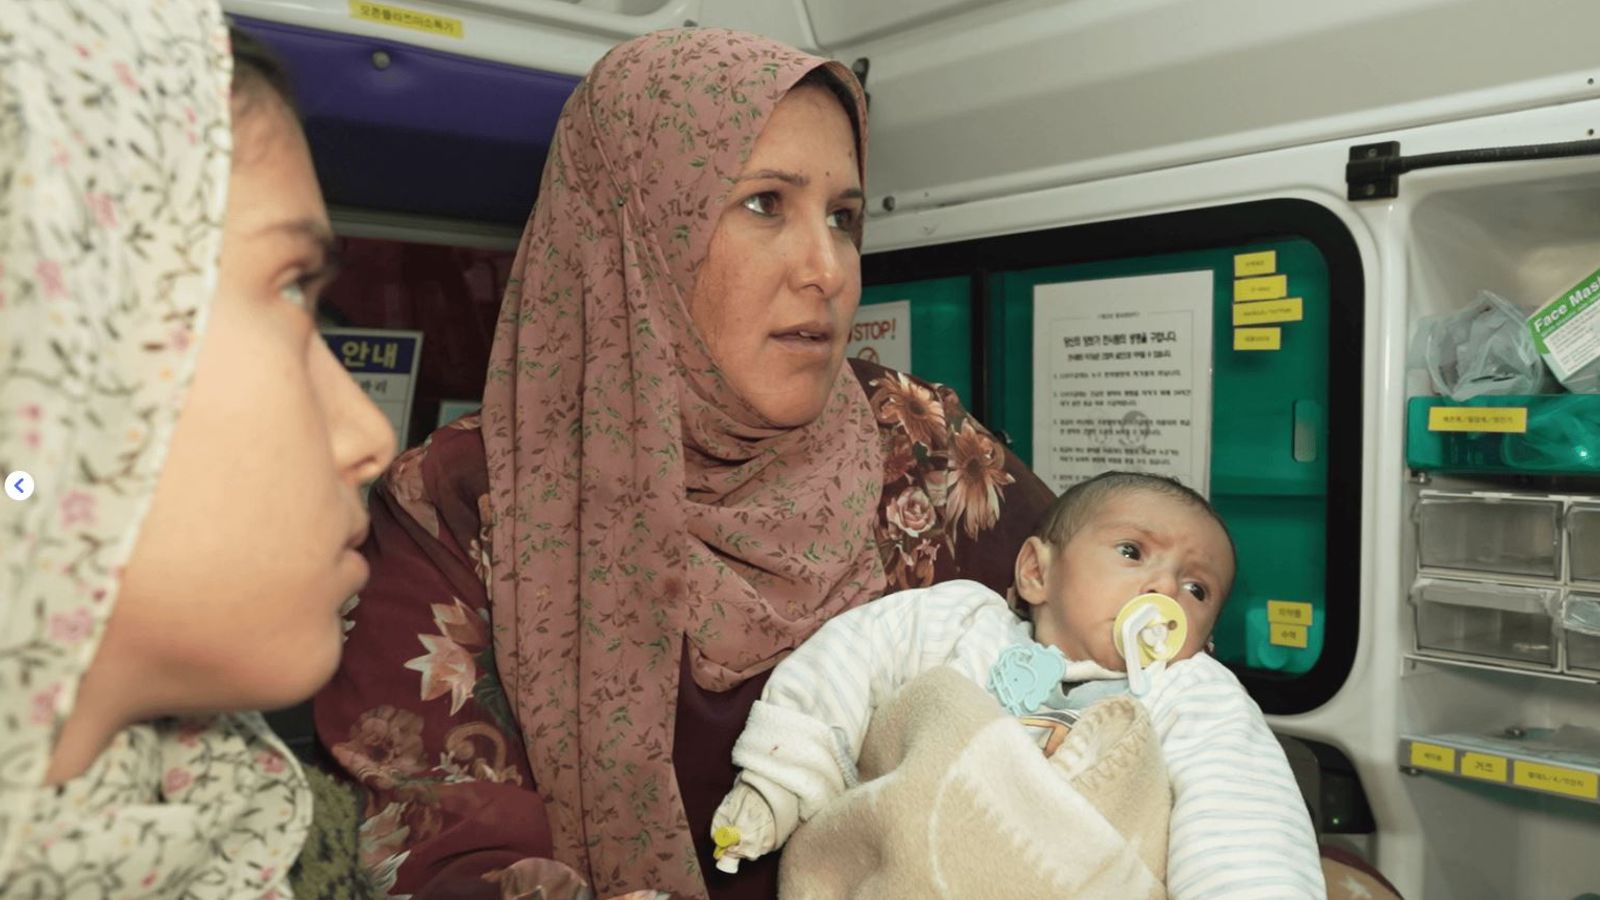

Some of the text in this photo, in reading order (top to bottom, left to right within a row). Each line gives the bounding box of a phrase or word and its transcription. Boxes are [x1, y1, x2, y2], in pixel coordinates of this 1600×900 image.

[853, 318, 896, 342] STOP!
[1534, 304, 1568, 332] Face
[341, 340, 398, 369] 안내
